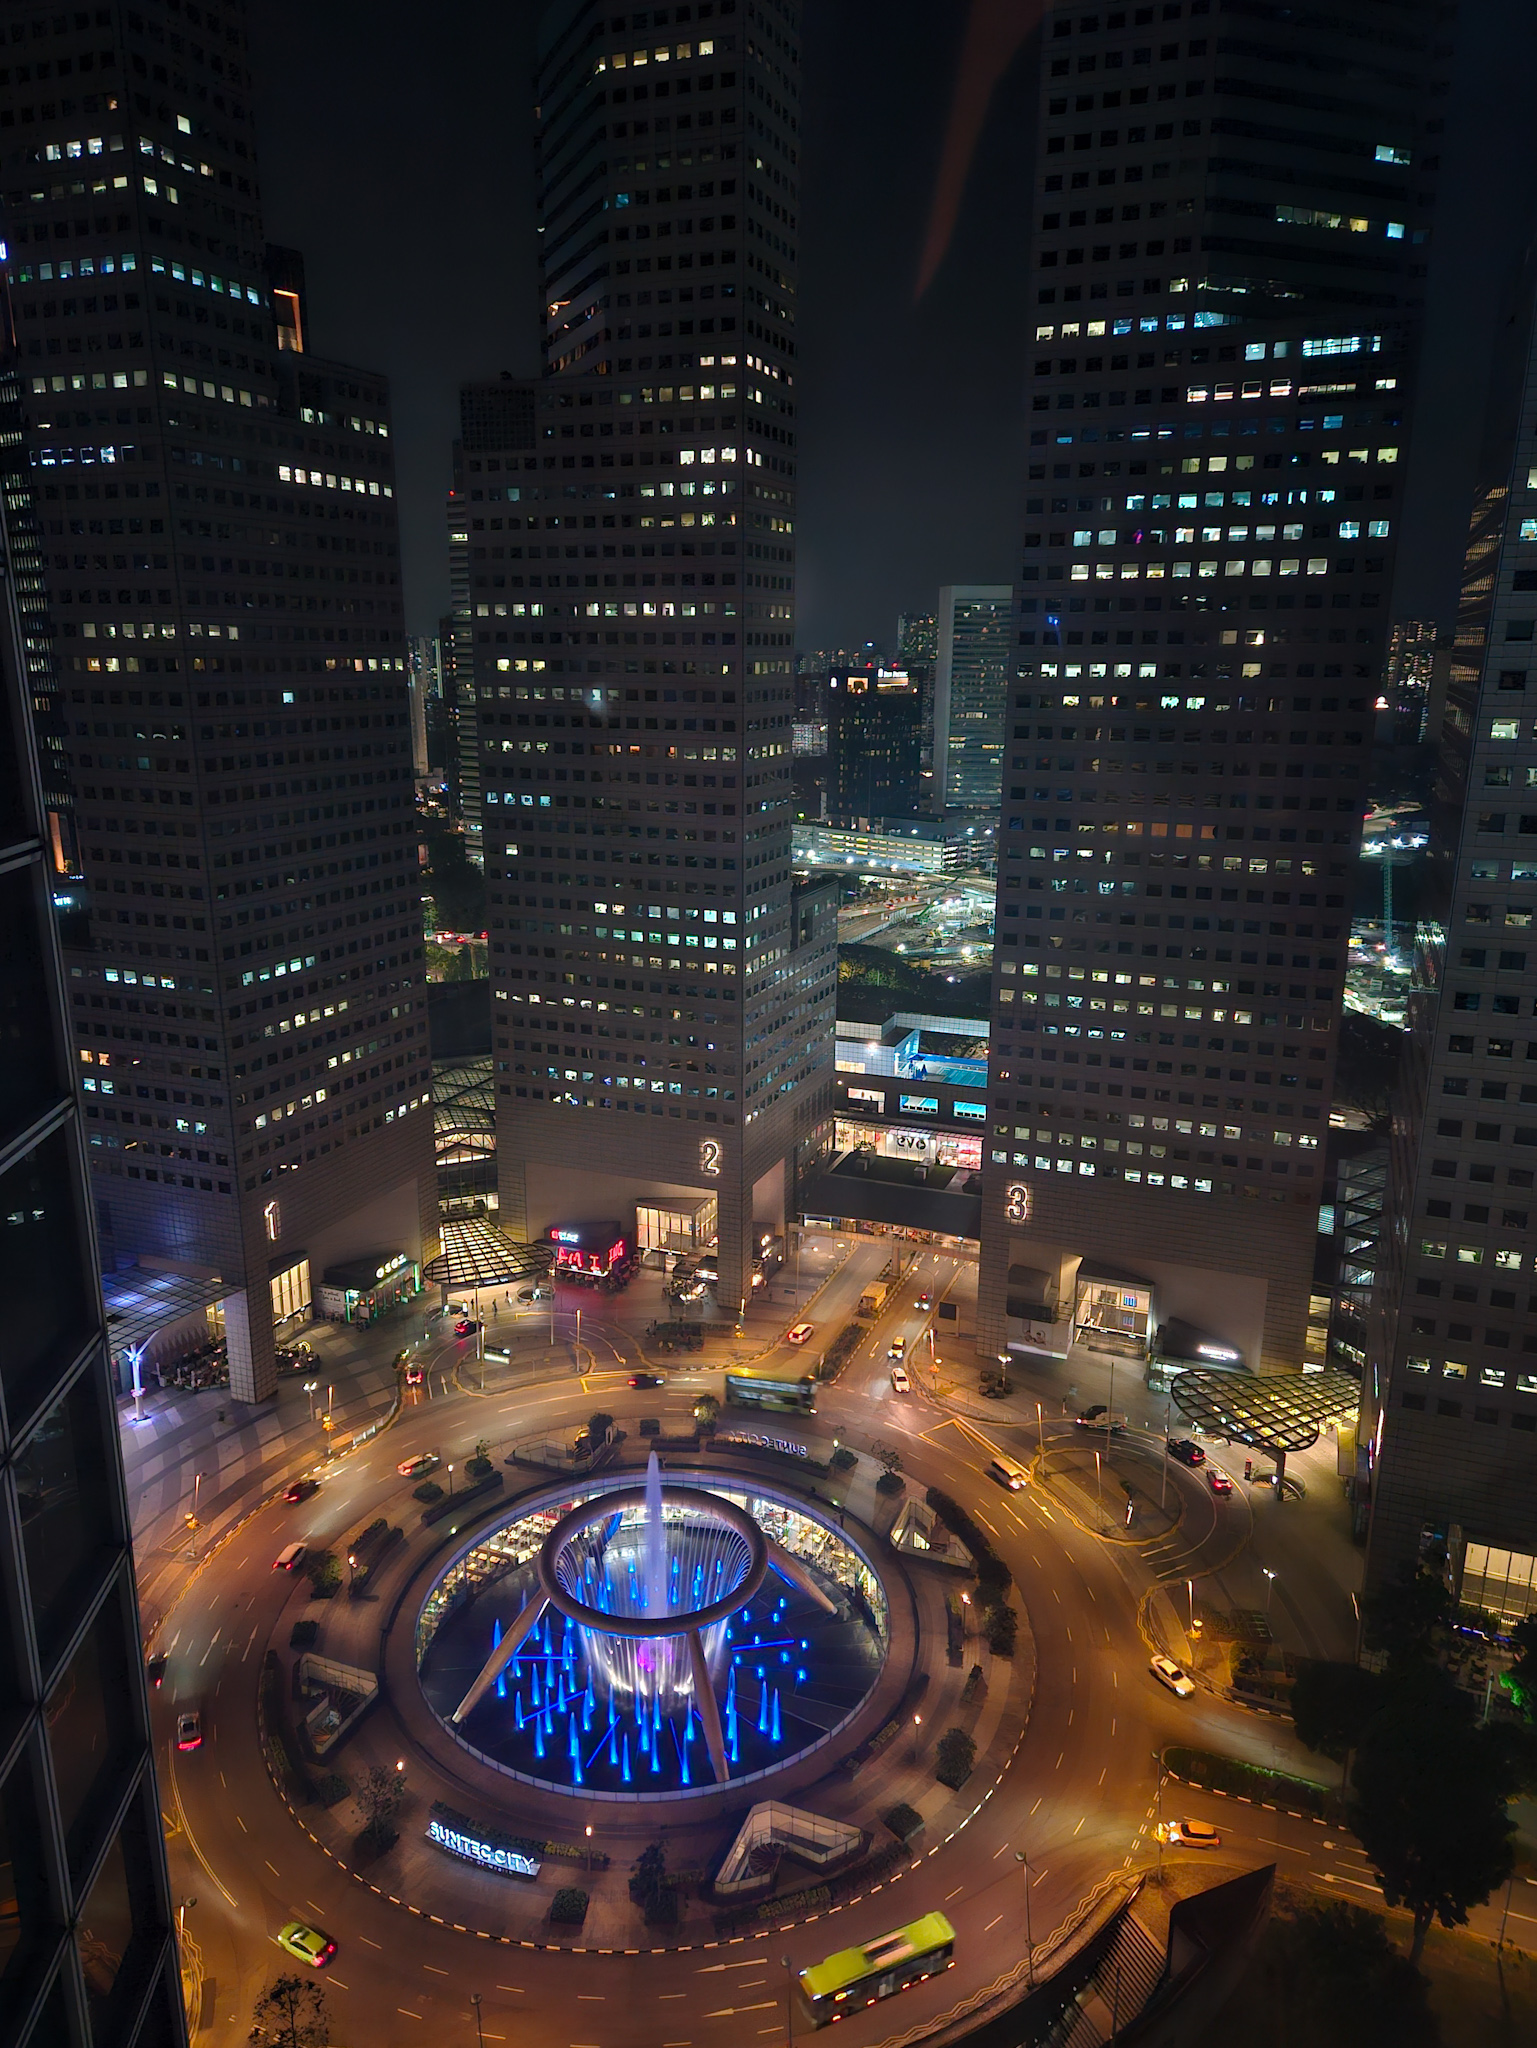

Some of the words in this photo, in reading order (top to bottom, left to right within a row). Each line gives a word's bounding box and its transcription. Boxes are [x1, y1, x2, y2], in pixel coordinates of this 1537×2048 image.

[702, 1141, 720, 1175] 2
[264, 1201, 278, 1240] 1
[1008, 1185, 1028, 1220] 3
[429, 1821, 492, 1861] SUNTEC
[494, 1849, 535, 1870] CITY
